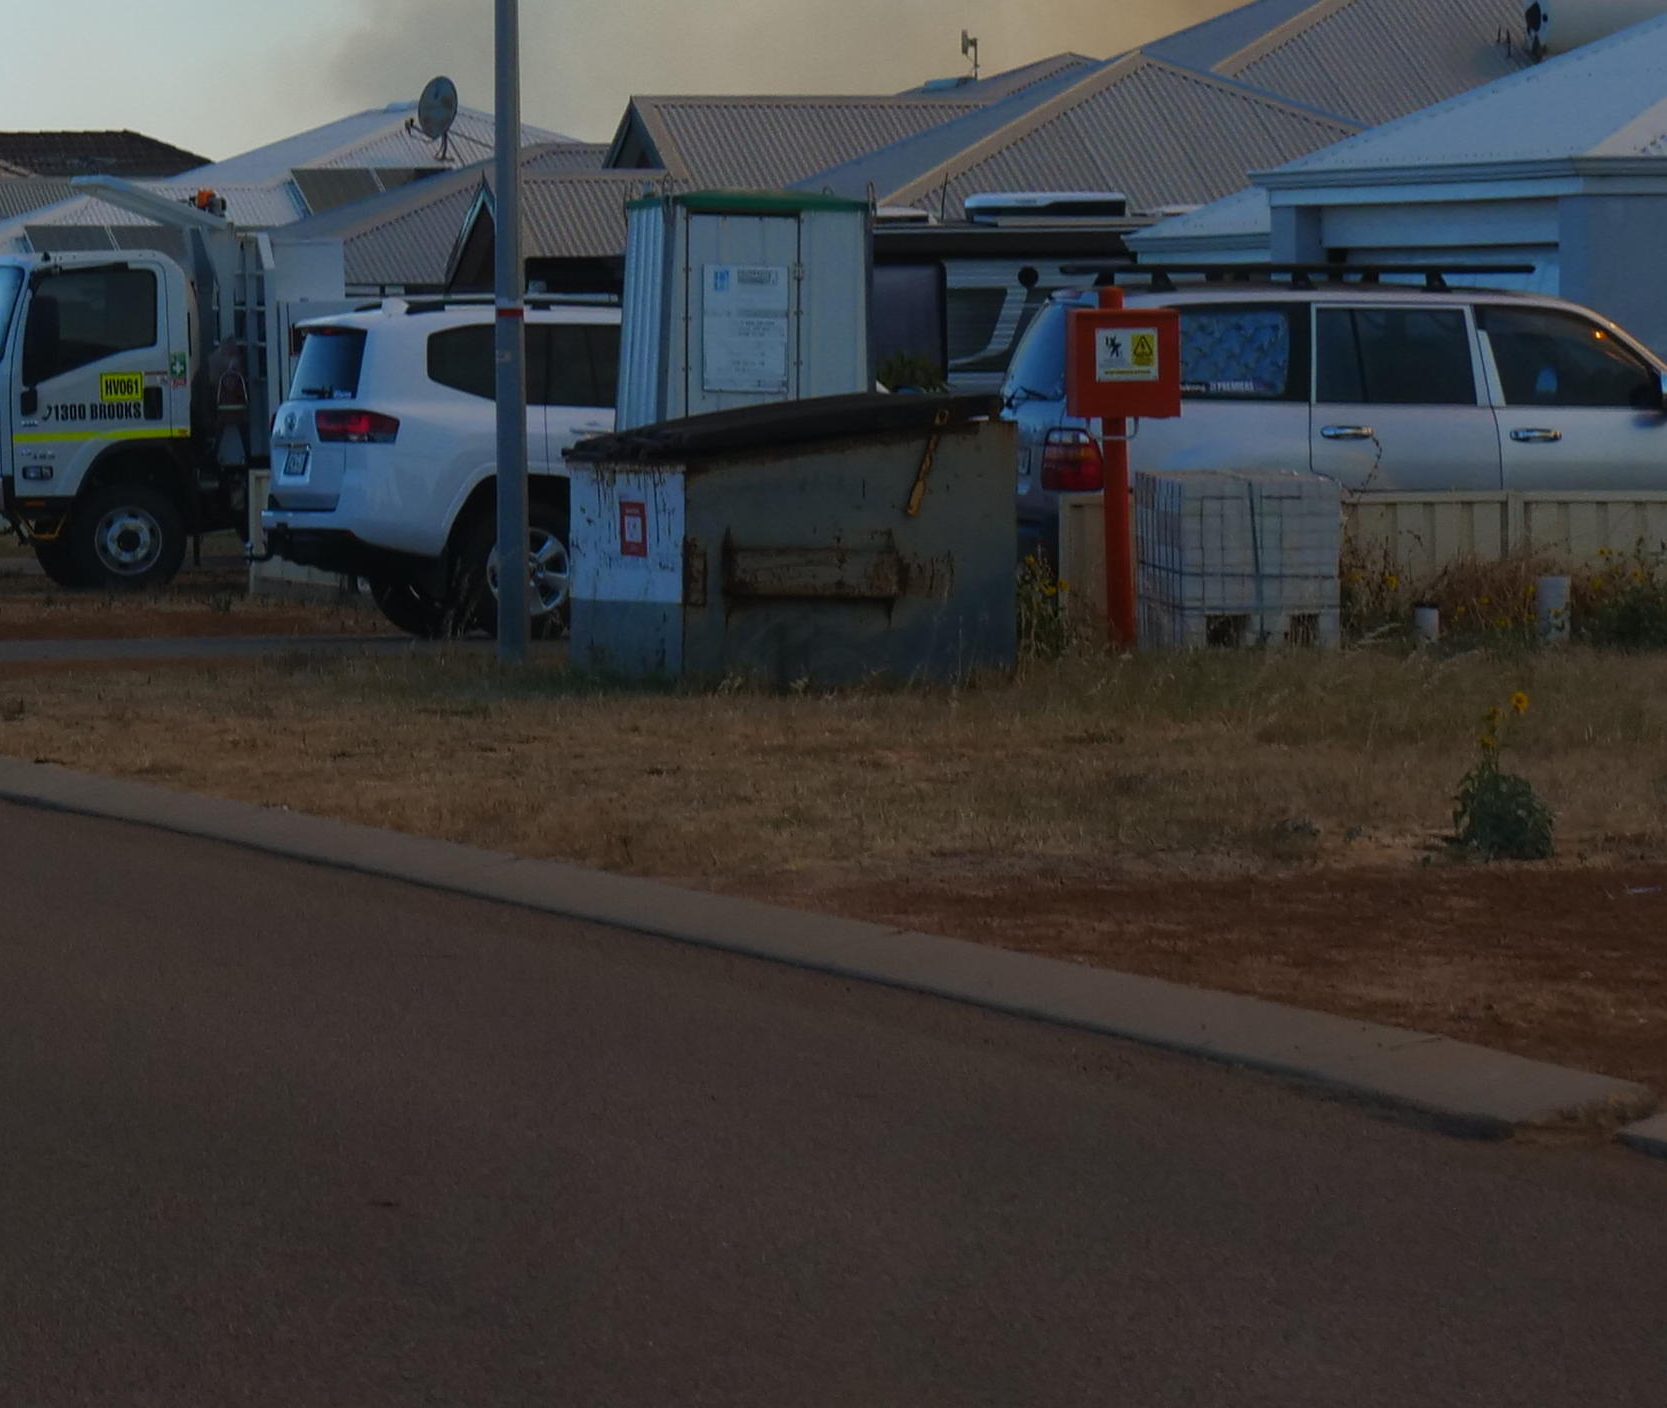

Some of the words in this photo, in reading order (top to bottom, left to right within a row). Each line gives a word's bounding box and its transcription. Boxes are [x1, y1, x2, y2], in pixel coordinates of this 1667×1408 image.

[104, 378, 139, 396] HV061
[54, 403, 86, 421] 1300
[90, 401, 142, 420] BROOKS
